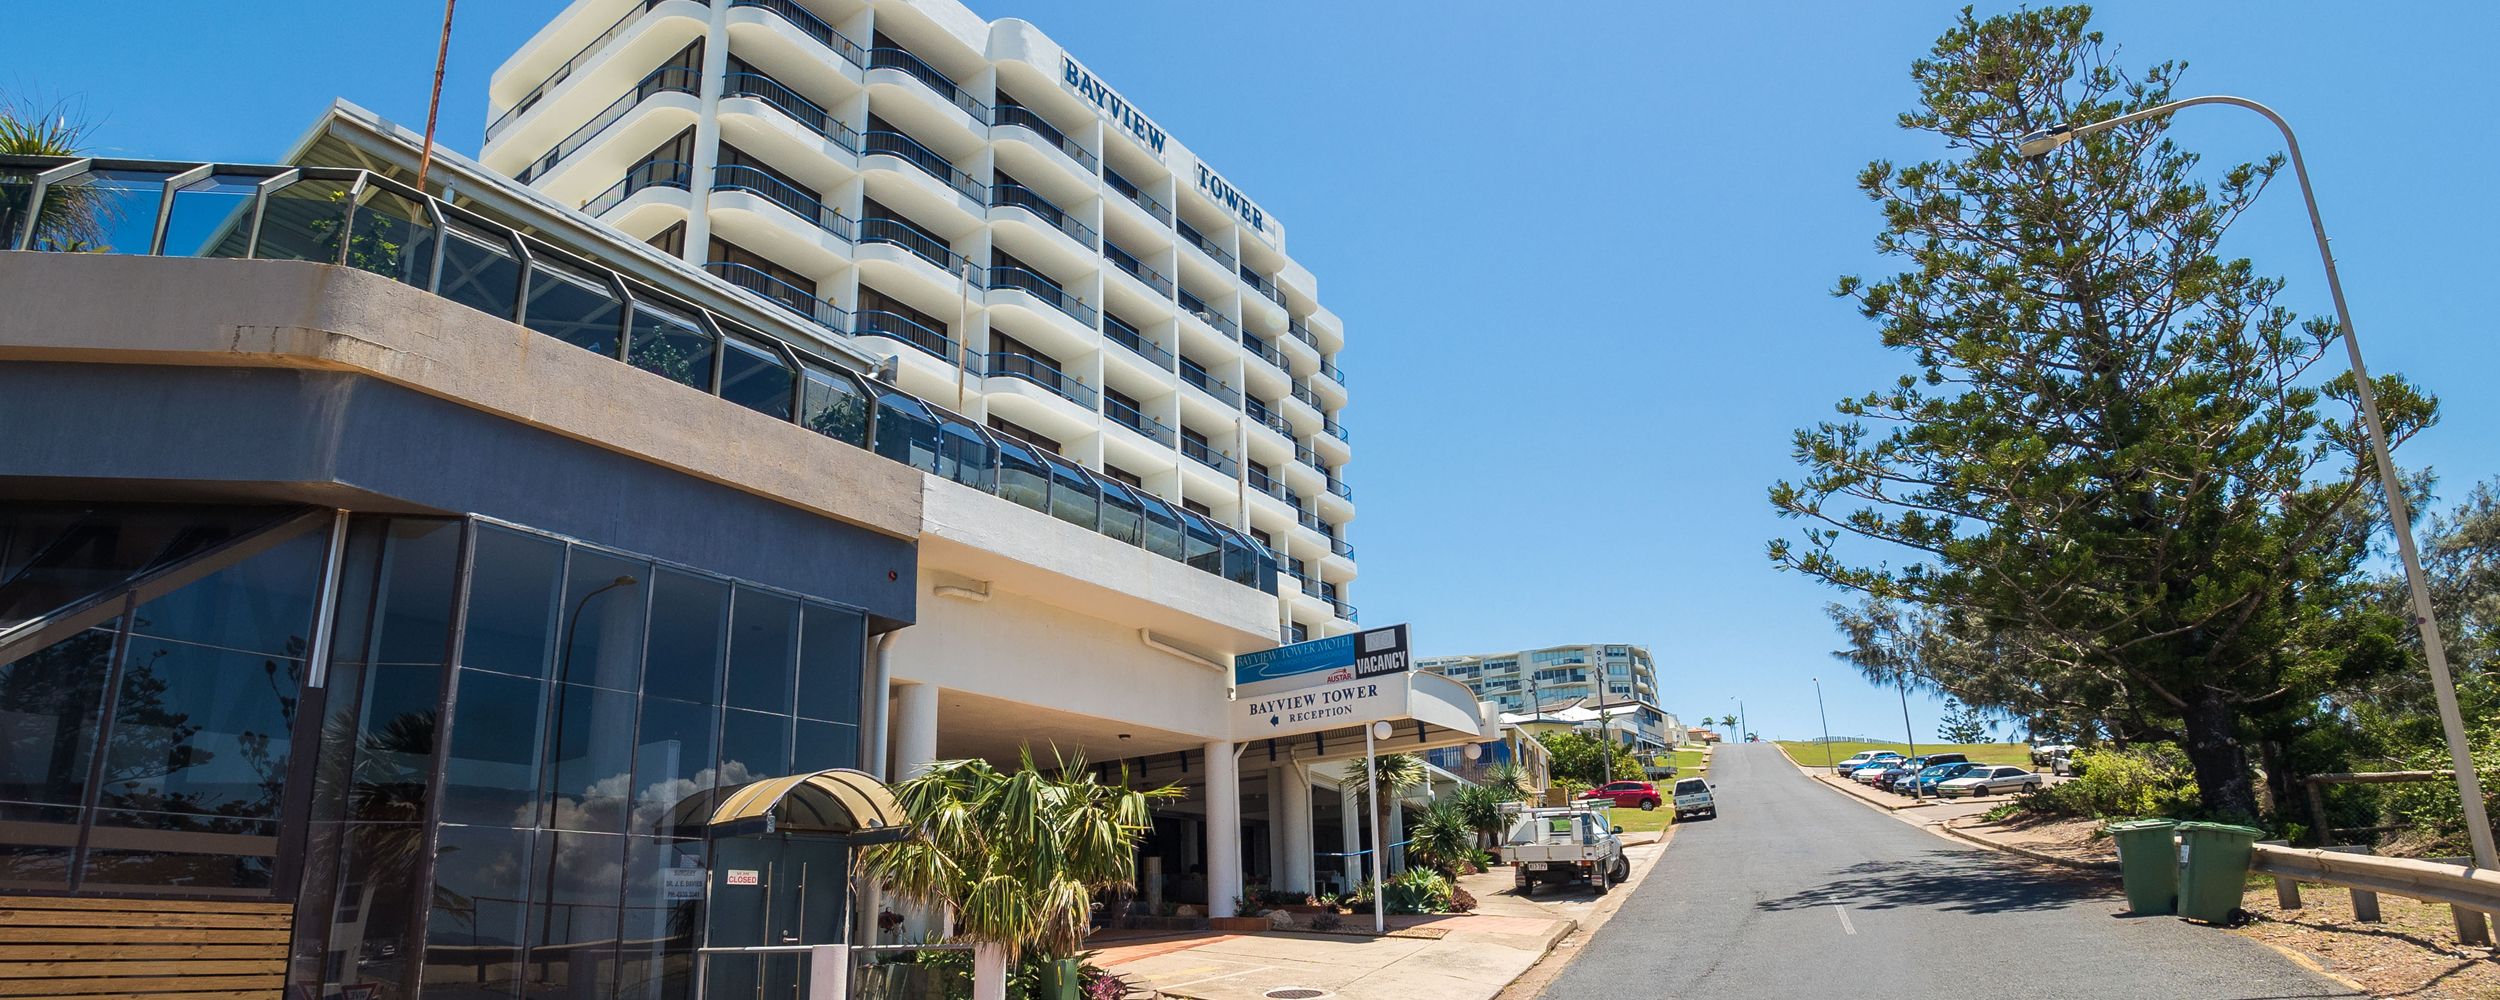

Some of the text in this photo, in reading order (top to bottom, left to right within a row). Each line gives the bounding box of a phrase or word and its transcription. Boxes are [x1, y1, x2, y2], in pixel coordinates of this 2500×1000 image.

[1064, 57, 1265, 233] BAYVIEW TOWER
[1368, 632, 1391, 647] NO
[1237, 649, 1278, 667] BAYVIEW
[1282, 644, 1315, 659] TOWER
[1318, 636, 1353, 651] MOTEL
[1356, 650, 1406, 674] VACANCY
[1327, 672, 1352, 684] AUSTAR
[1249, 684, 1378, 715] BAYVIEW TOWER
[1289, 704, 1353, 723] RECEPTION
[728, 876, 757, 884] CLOSED
